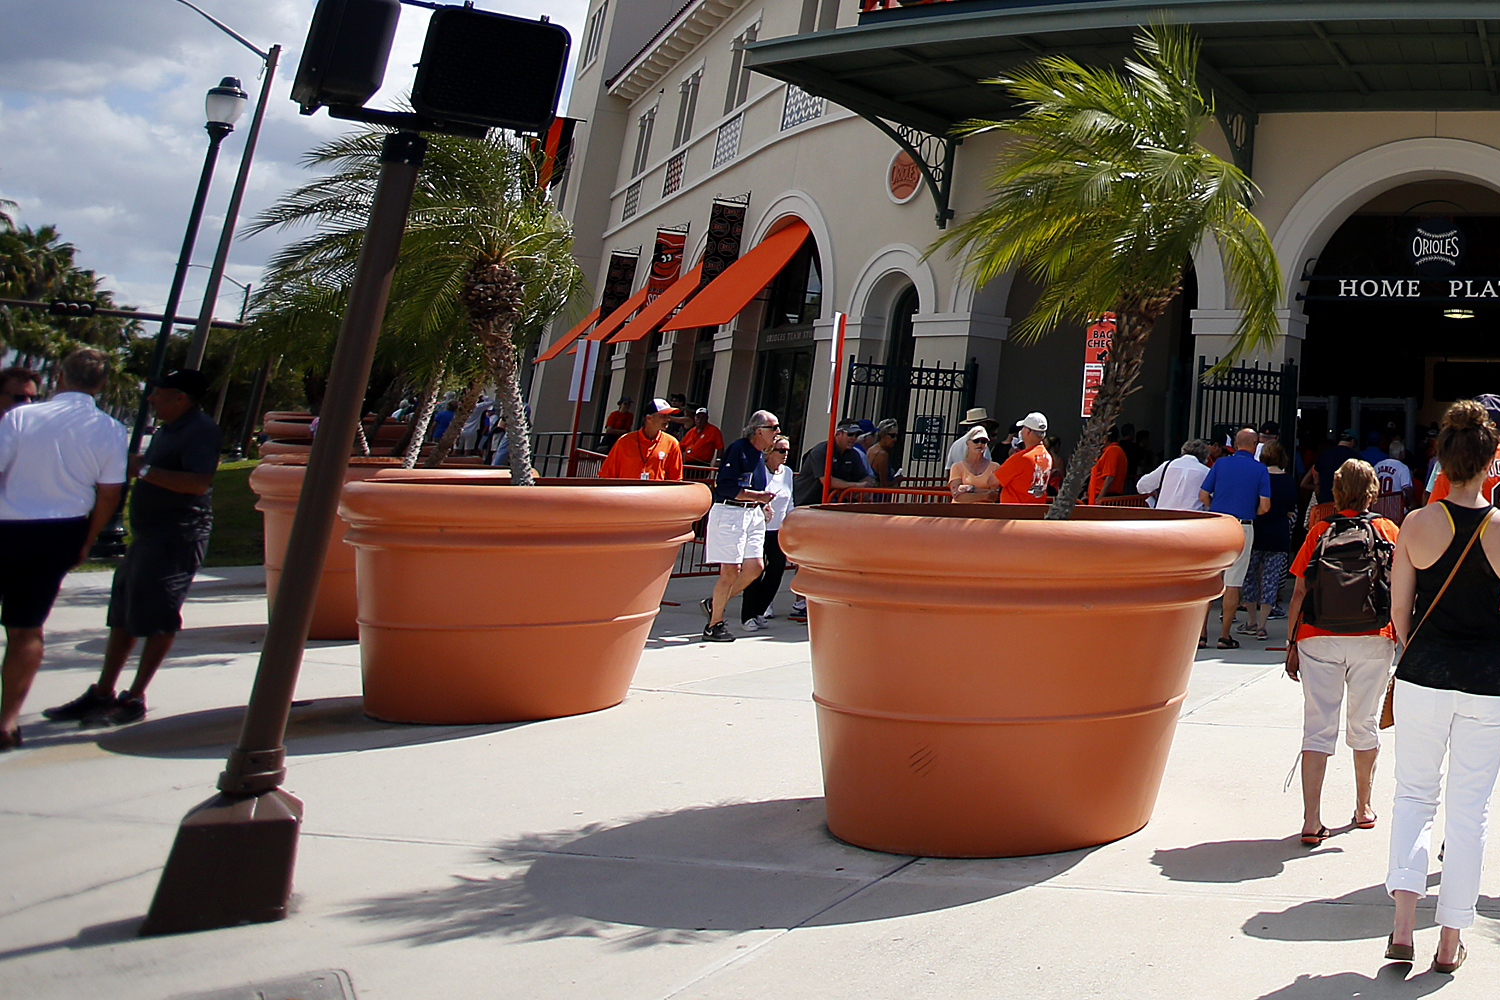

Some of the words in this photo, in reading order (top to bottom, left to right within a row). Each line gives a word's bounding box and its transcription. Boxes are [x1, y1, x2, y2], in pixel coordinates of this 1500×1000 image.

[1412, 236, 1460, 258] ORIOLES
[1338, 279, 1421, 298] HOME
[802, 330, 813, 339] STO
[1093, 330, 1113, 338] BAG
[1087, 340, 1112, 348] CHEC
[1377, 465, 1397, 476] JONES
[1379, 476, 1394, 493] 10
